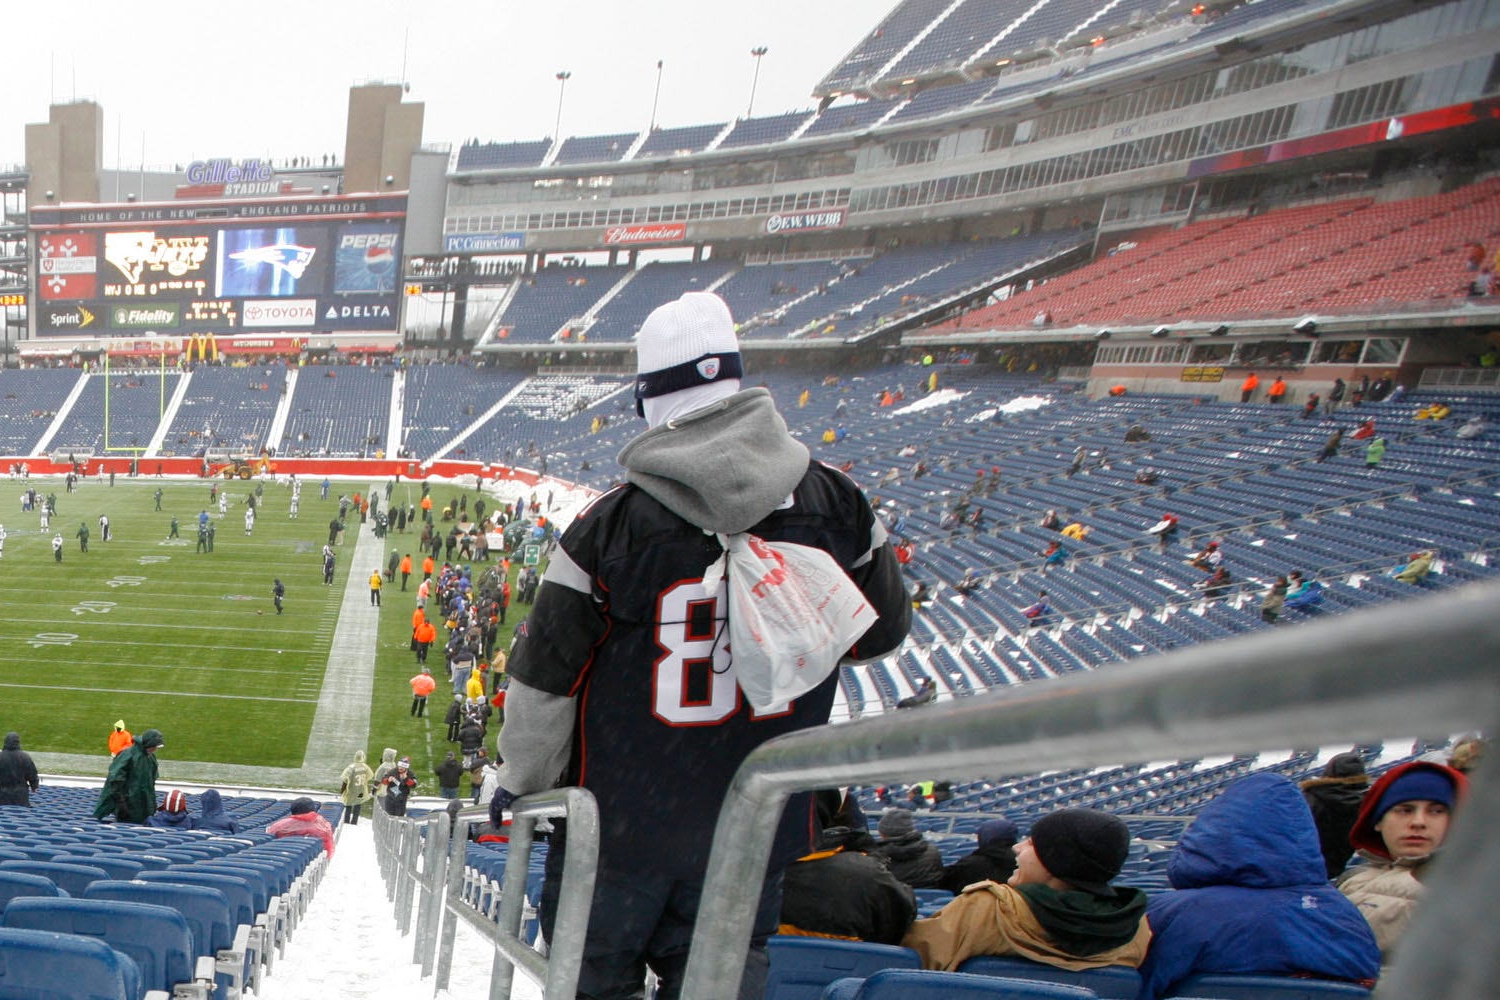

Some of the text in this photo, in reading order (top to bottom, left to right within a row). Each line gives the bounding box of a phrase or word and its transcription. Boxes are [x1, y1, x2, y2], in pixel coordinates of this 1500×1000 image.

[186, 158, 272, 184] Gillette
[225, 182, 279, 195] STADIUM
[80, 203, 367, 221] HOME OF THE NEW ENGLAND PATRIOTS
[805, 212, 842, 227] WEBB
[340, 233, 398, 249] PEPSI
[606, 226, 682, 244] Budweiser
[447, 236, 520, 251] PC Connection
[128, 310, 175, 324] Fidelity
[264, 307, 313, 319] TOYOTA
[341, 306, 391, 317] DELTA
[50, 312, 80, 327] Sprint
